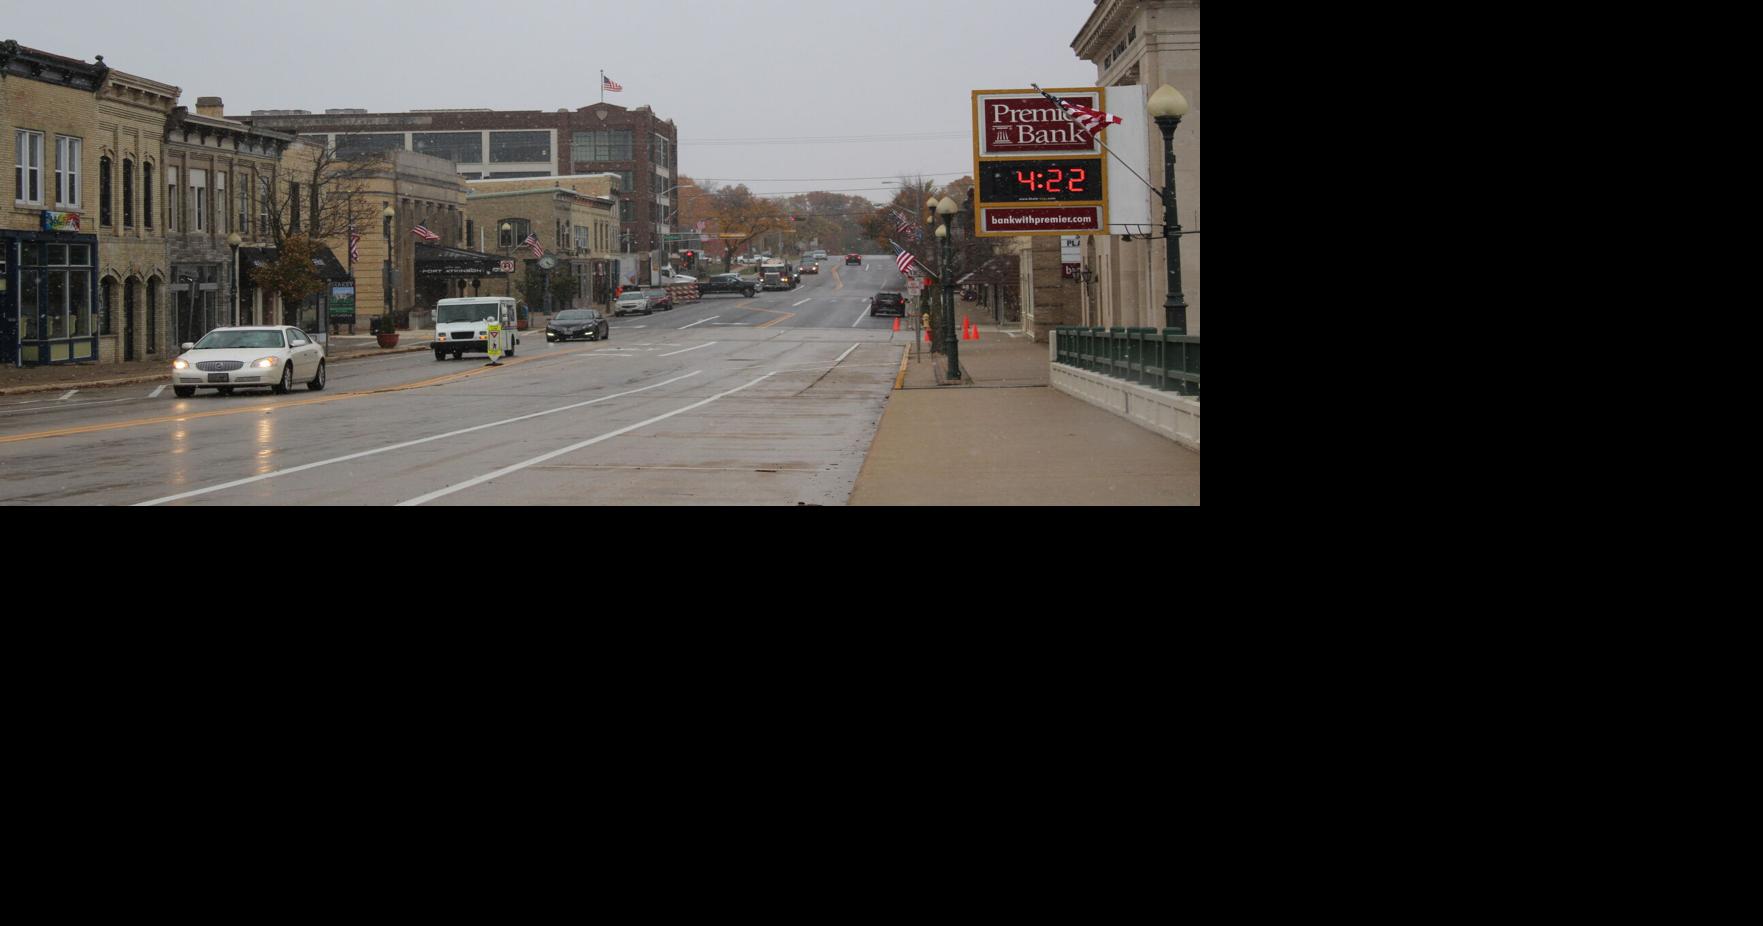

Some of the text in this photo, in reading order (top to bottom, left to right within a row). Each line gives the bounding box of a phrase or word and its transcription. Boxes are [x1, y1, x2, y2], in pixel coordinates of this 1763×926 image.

[992, 104, 1074, 123] Premie
[1016, 122, 1087, 144] Bank
[1017, 168, 1085, 193] 4:22
[991, 215, 1092, 225] bankwithpremier.com
